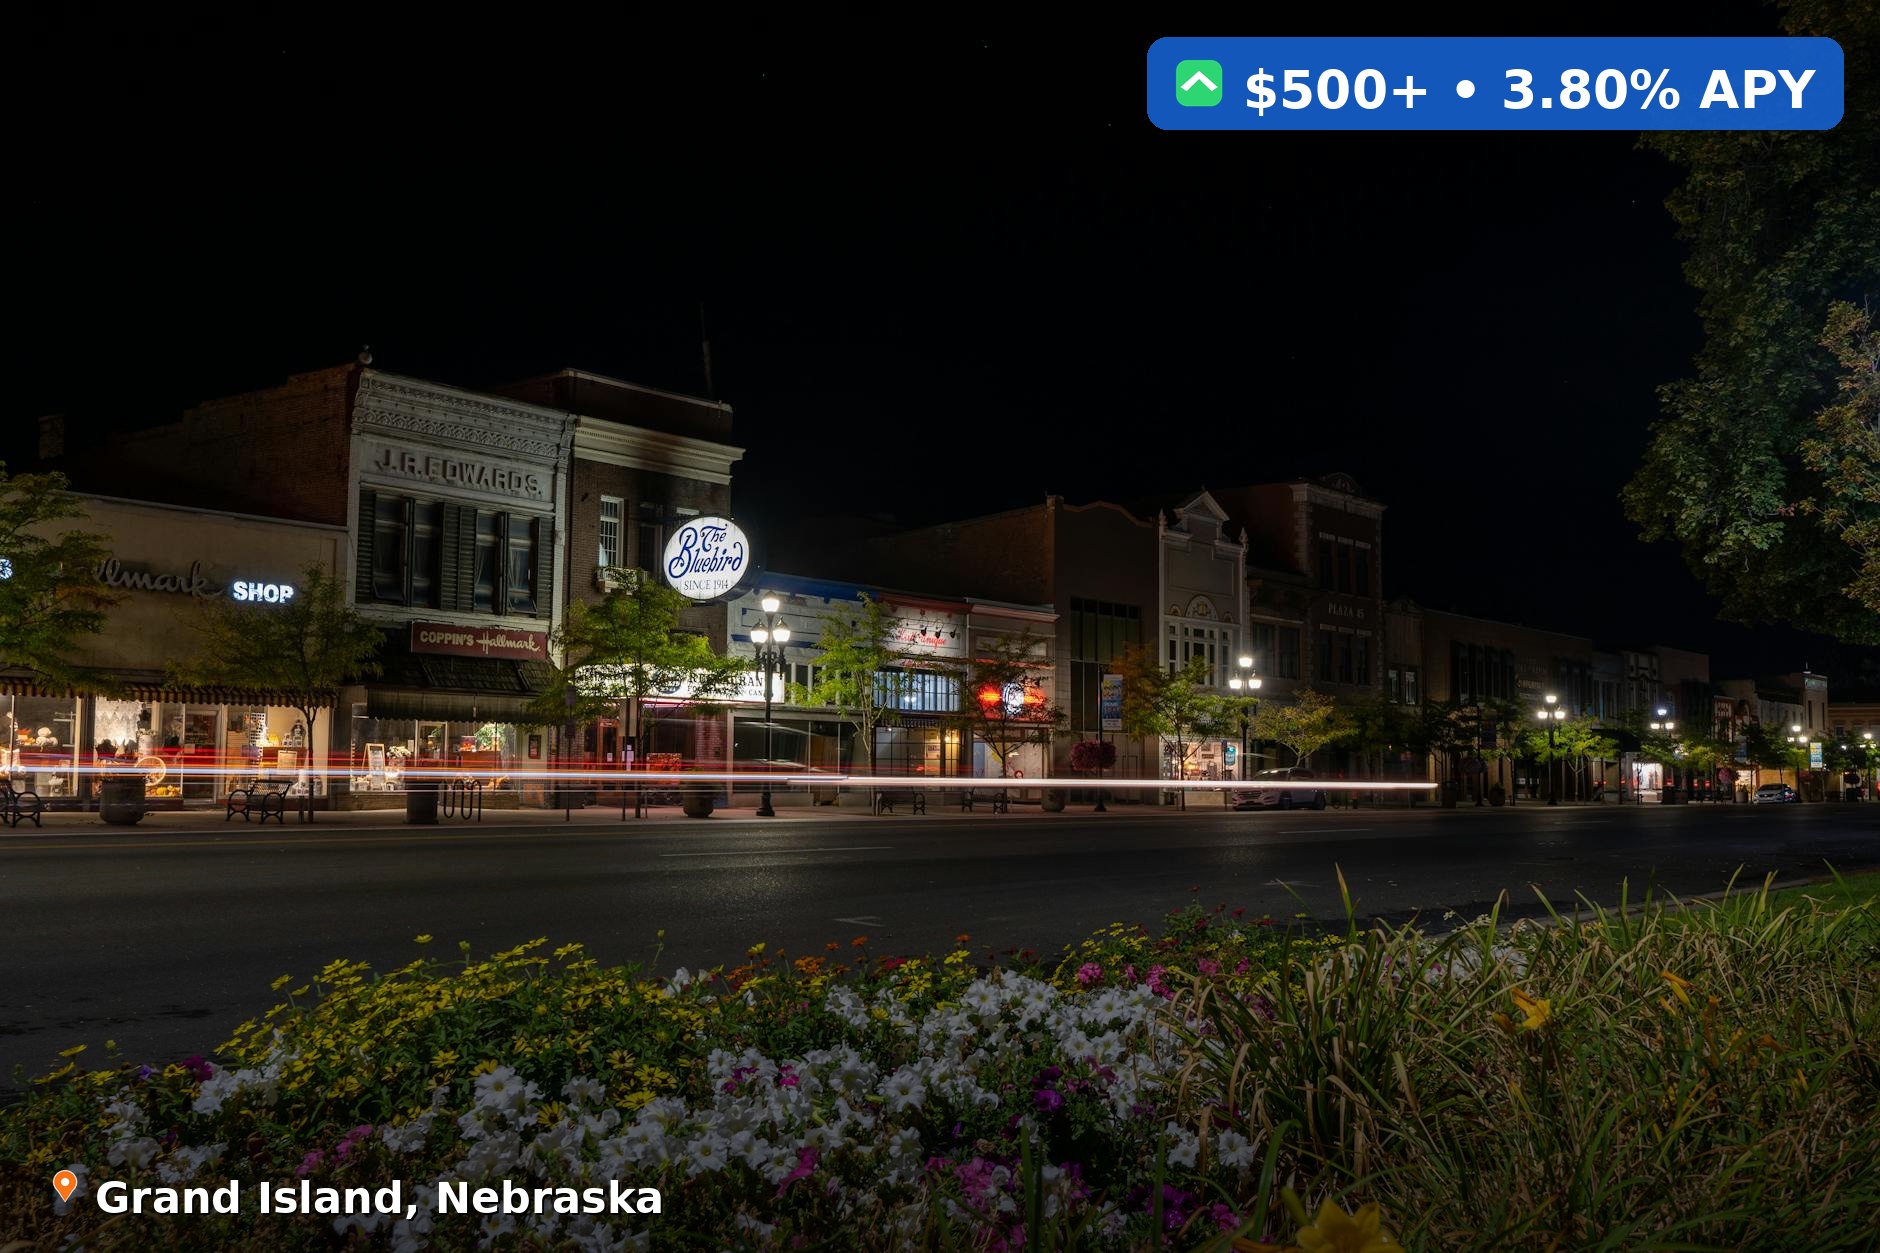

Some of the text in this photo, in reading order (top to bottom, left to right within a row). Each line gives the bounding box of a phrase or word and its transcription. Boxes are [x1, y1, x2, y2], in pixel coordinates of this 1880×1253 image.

[700, 523, 728, 552] The
[668, 527, 744, 579] Bluebird
[91, 558, 295, 604] llmark SHOP
[684, 579, 729, 591] SINCE 1914
[1328, 602, 1354, 617] PLAZA
[419, 631, 542, 655] COPPIN'S Hallmark
